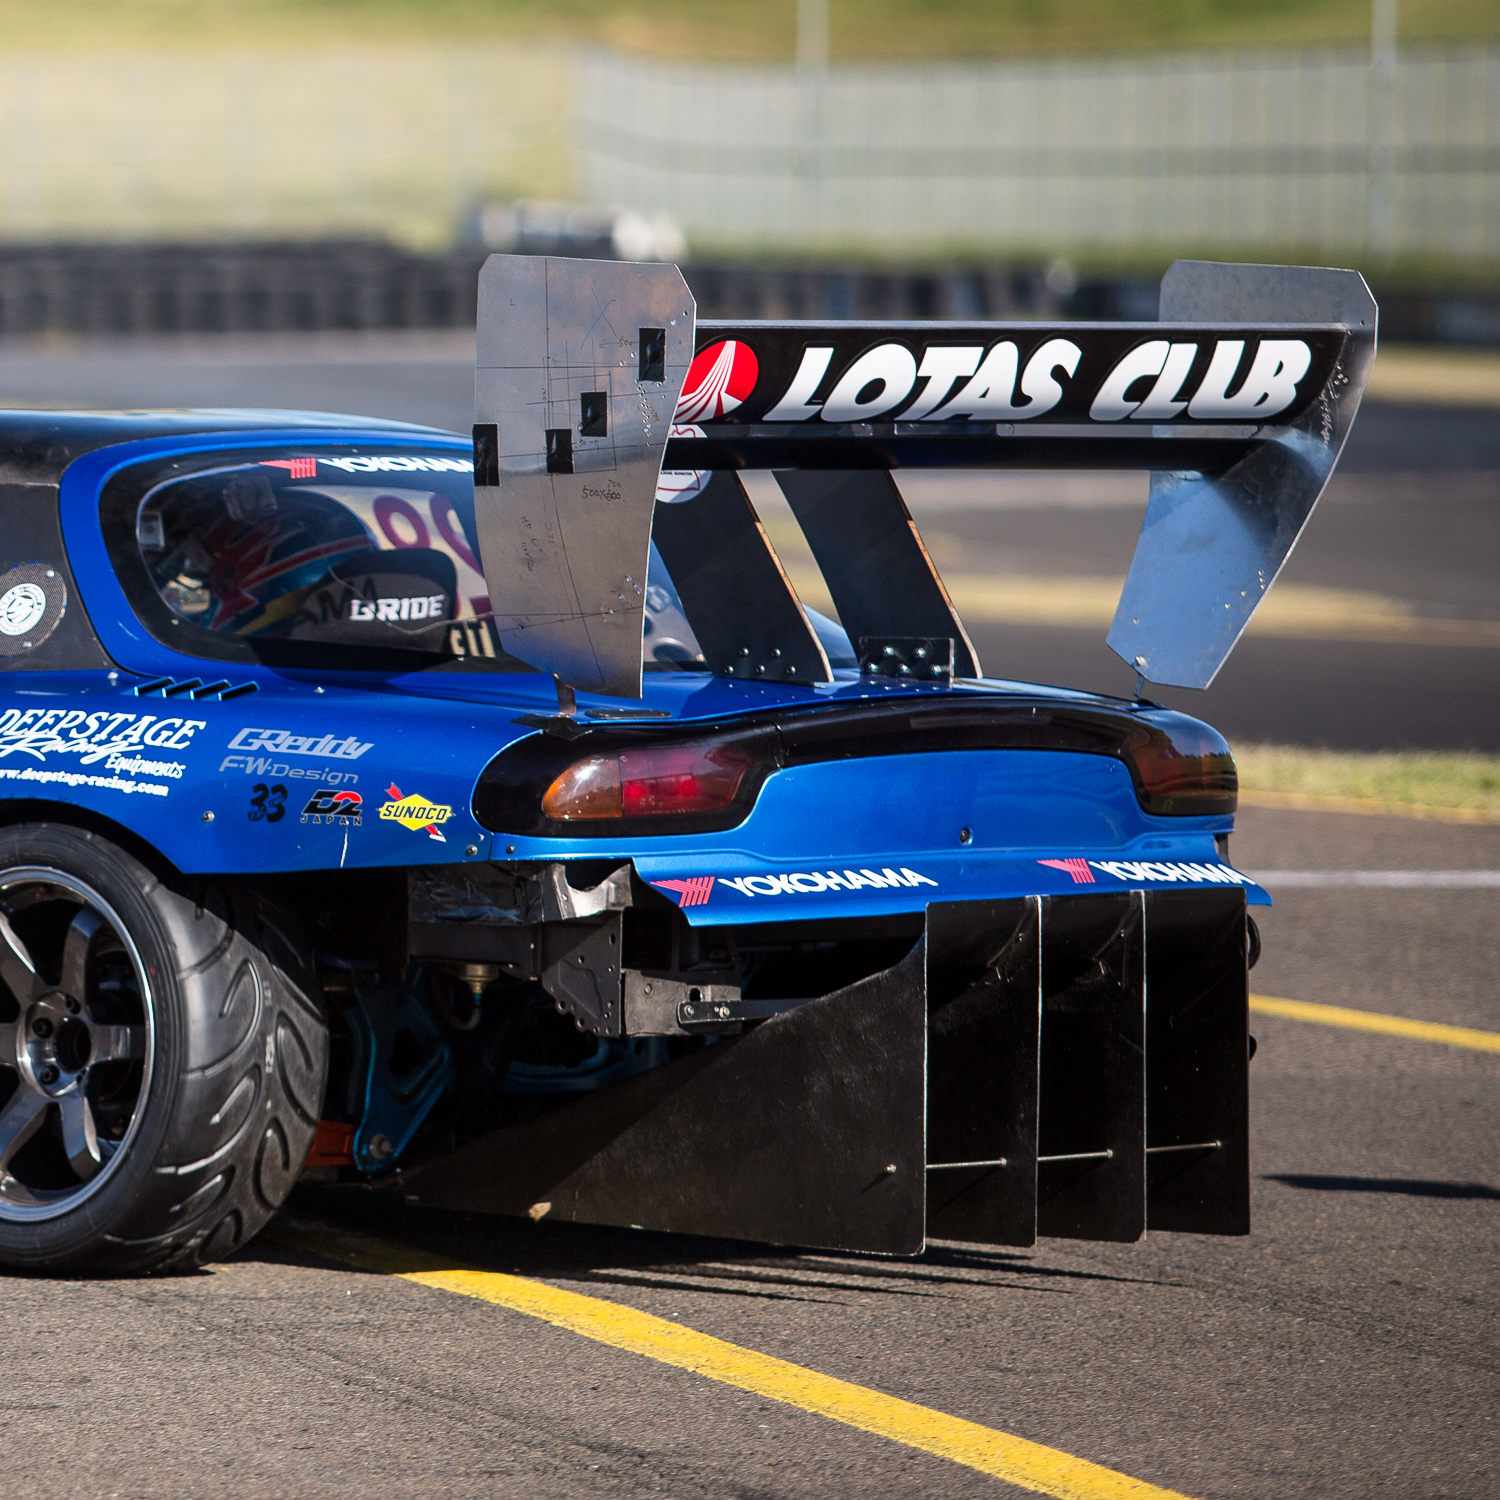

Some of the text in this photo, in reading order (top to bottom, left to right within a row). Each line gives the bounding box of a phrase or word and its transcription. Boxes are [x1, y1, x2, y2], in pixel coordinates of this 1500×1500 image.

[762, 338, 1082, 421] LOTAS
[1089, 338, 1312, 421] CLUB
[317, 456, 475, 473] YOKOHAM
[350, 594, 445, 622] BRIDE
[227, 727, 375, 760] GReddy
[104, 752, 186, 779] Equipments
[301, 789, 363, 817] D2
[382, 803, 449, 821] SUNOCO
[300, 815, 363, 826] JAPAN
[717, 867, 939, 897] YOKOHAMA
[1088, 861, 1256, 886] YOKOHAMA
